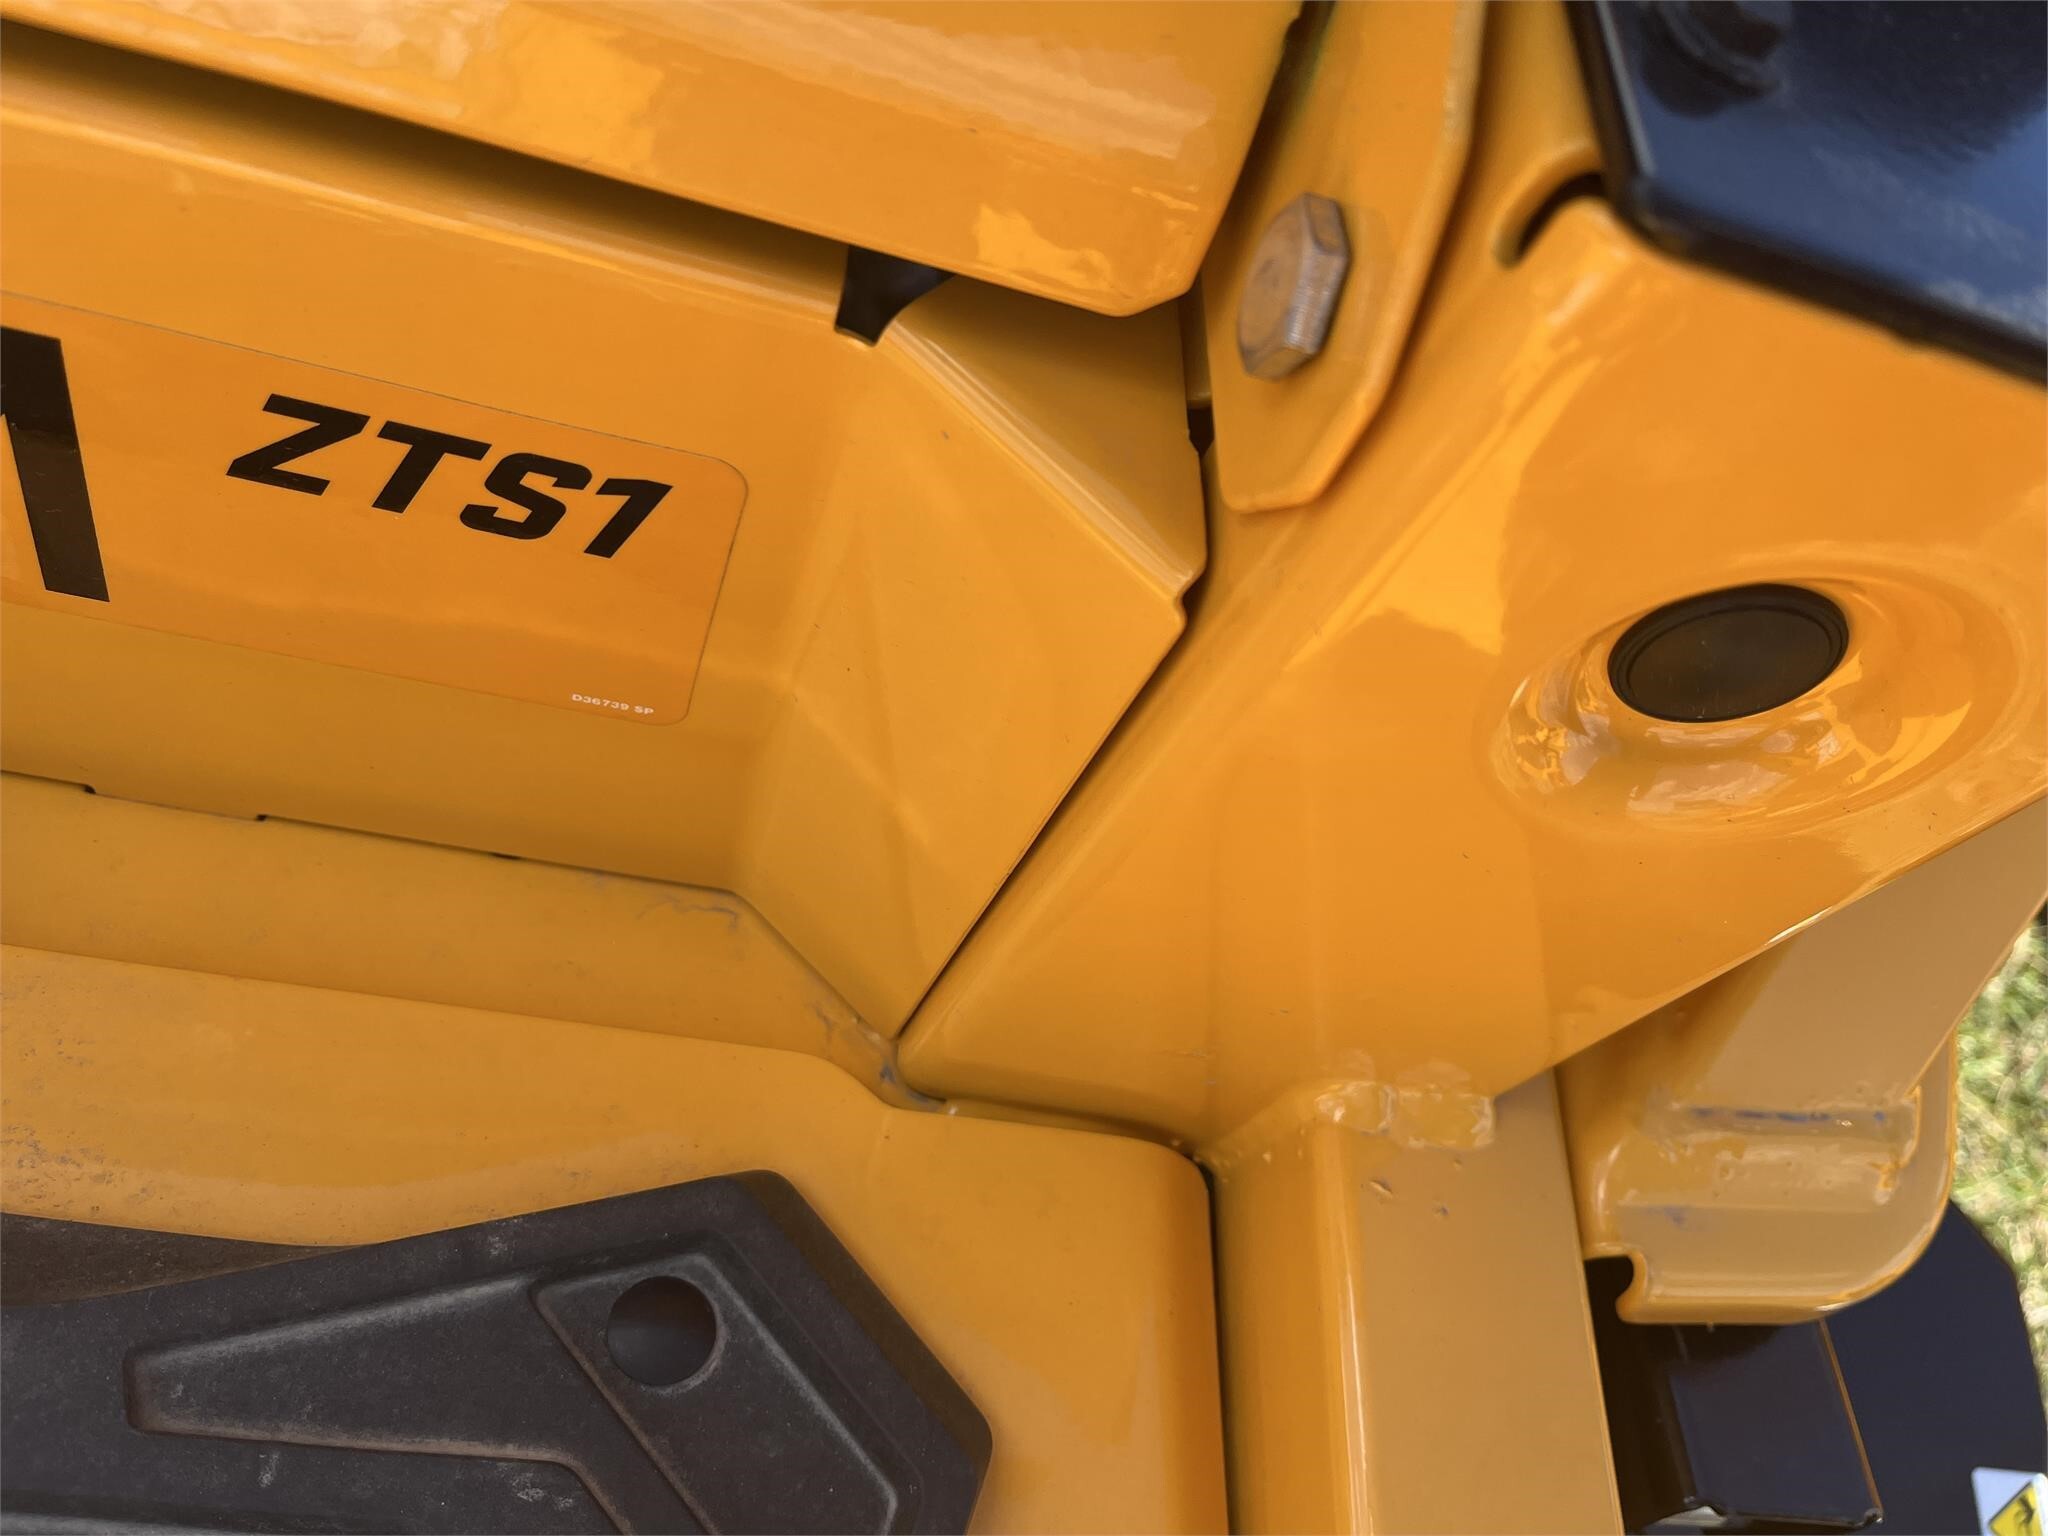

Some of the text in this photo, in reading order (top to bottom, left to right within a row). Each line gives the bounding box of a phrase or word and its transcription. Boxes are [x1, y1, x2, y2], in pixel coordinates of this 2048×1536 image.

[226, 394, 673, 558] ZTS1
[571, 693, 654, 714] D36739 SP
